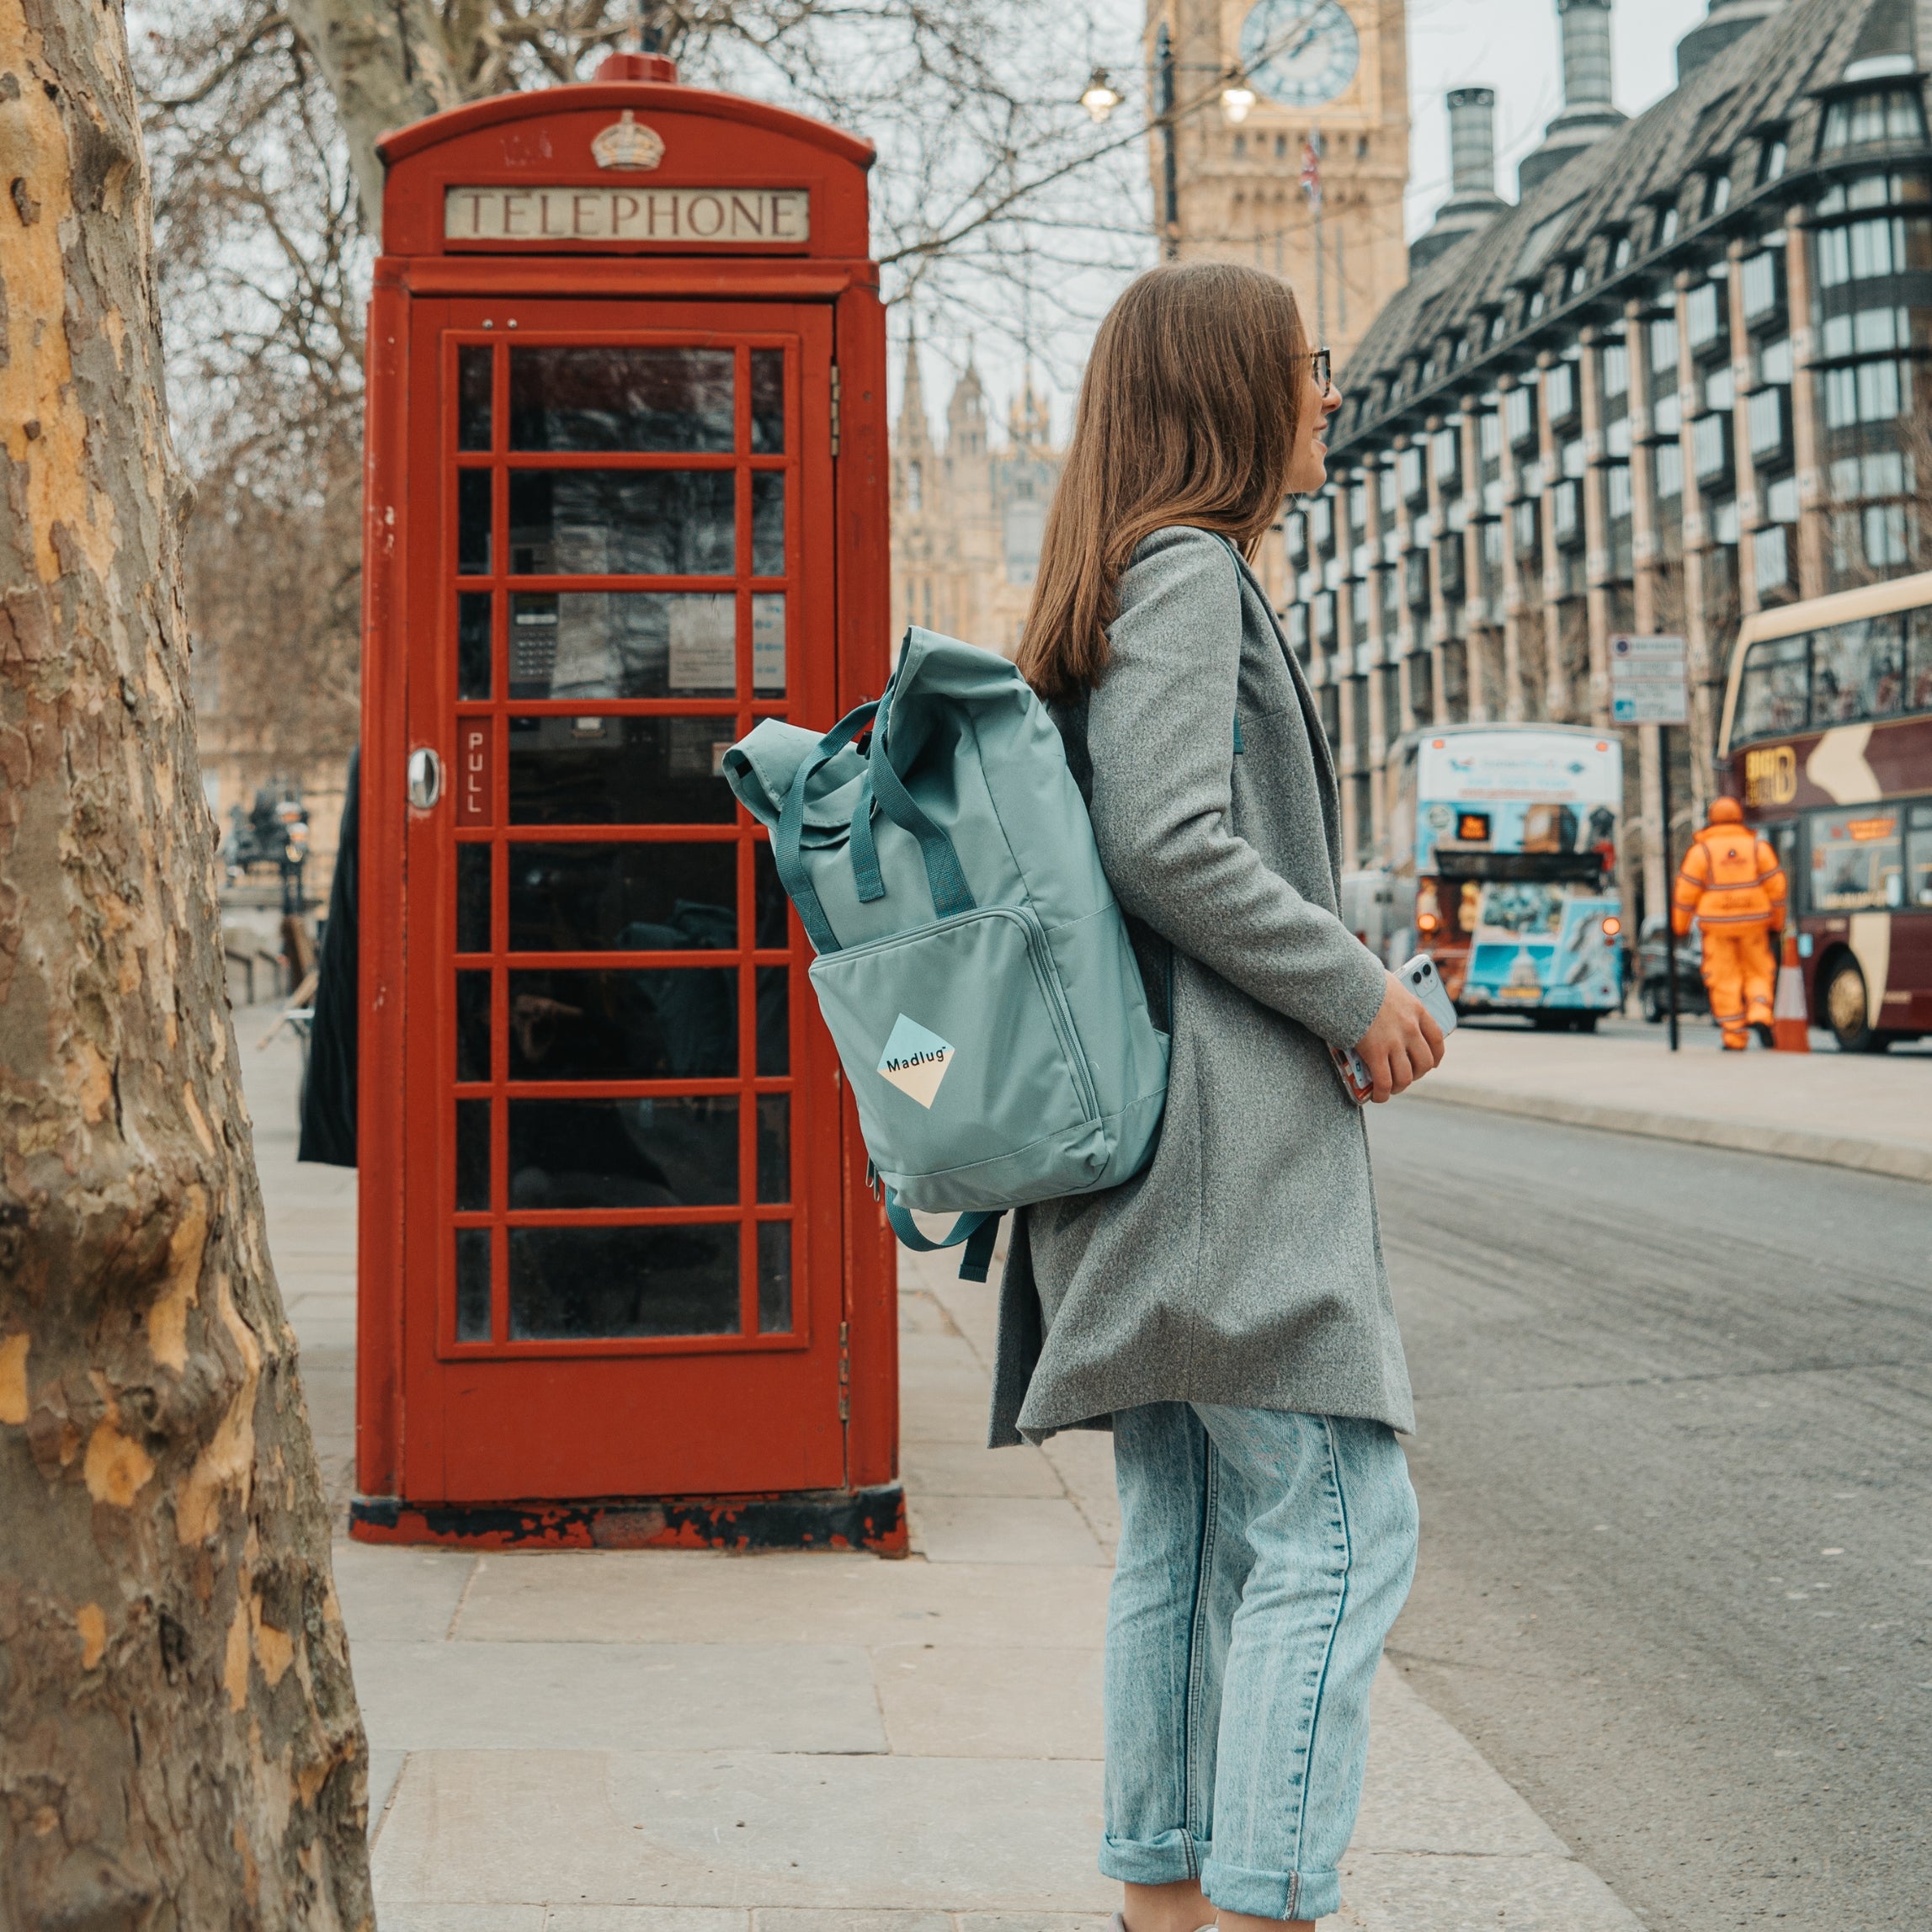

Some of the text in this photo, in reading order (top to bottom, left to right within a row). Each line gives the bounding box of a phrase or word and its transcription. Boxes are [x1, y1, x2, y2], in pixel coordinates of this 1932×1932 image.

[462, 193, 797, 237] TELEPHONE
[468, 732, 483, 813] PULL
[886, 1049, 945, 1072] Madlug
